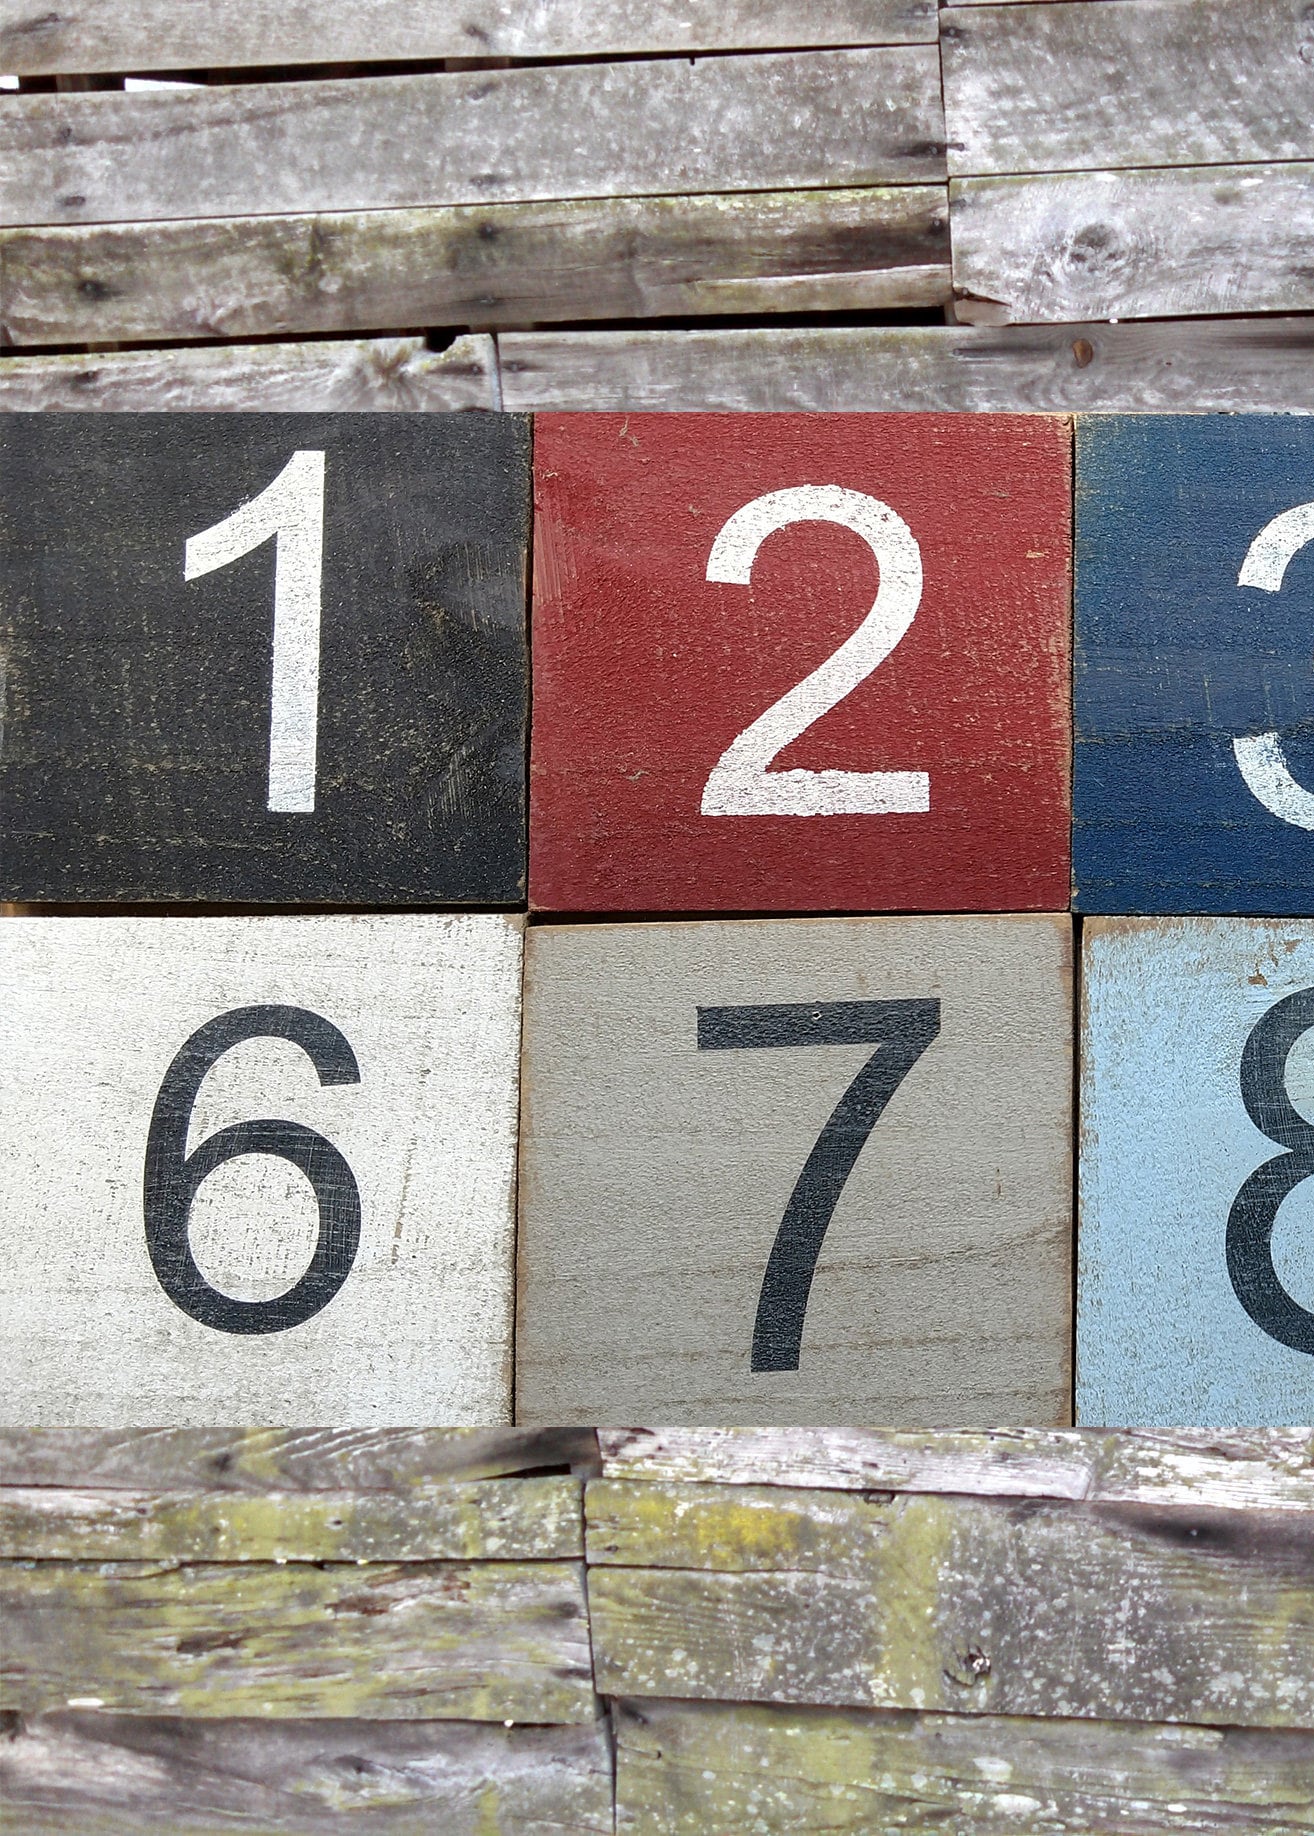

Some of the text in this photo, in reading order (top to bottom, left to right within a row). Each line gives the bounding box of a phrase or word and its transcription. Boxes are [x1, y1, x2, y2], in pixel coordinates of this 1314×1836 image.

[184, 451, 325, 814] 1
[701, 484, 930, 817] 2
[143, 1005, 361, 1335] 6
[697, 998, 941, 1372] 7
